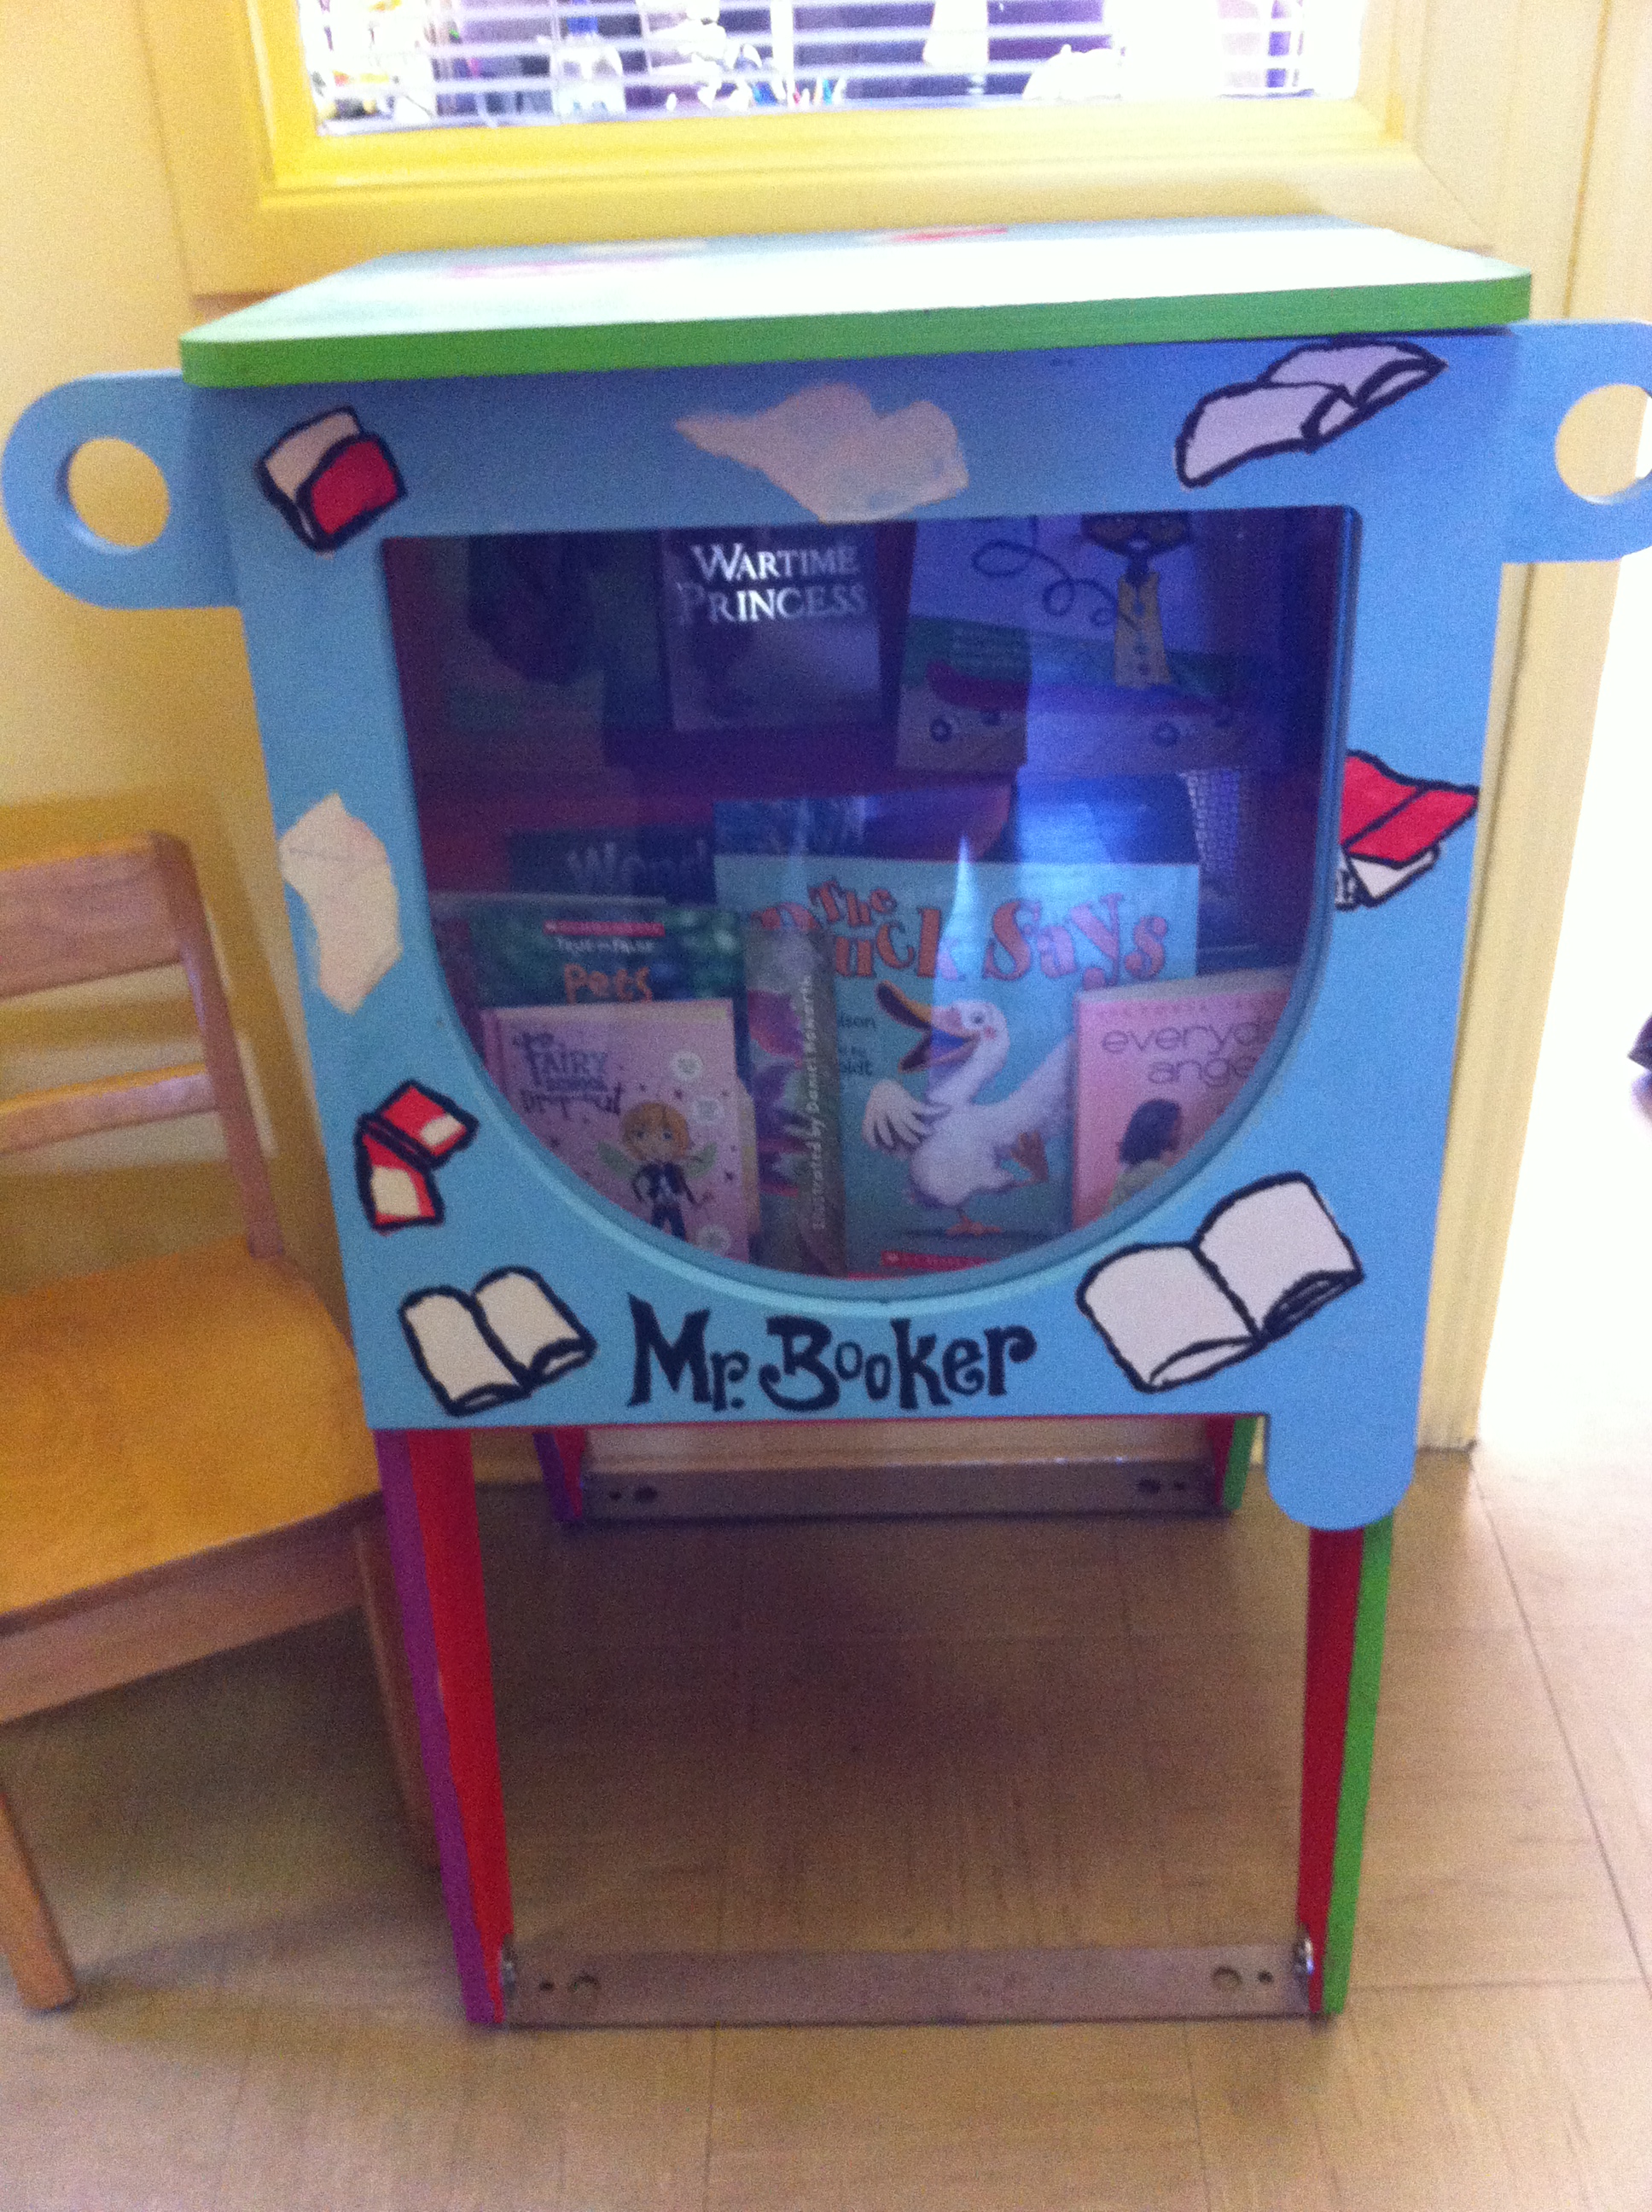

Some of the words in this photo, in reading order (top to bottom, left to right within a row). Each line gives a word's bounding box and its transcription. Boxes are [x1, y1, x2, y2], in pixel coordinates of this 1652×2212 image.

[689, 542, 860, 582] WARTIME
[675, 581, 867, 625] PRINCESS
[807, 878, 899, 926] The
[983, 892, 1167, 990] Says
[627, 1291, 751, 1412] Mr.
[759, 1314, 1038, 1412] Booker
